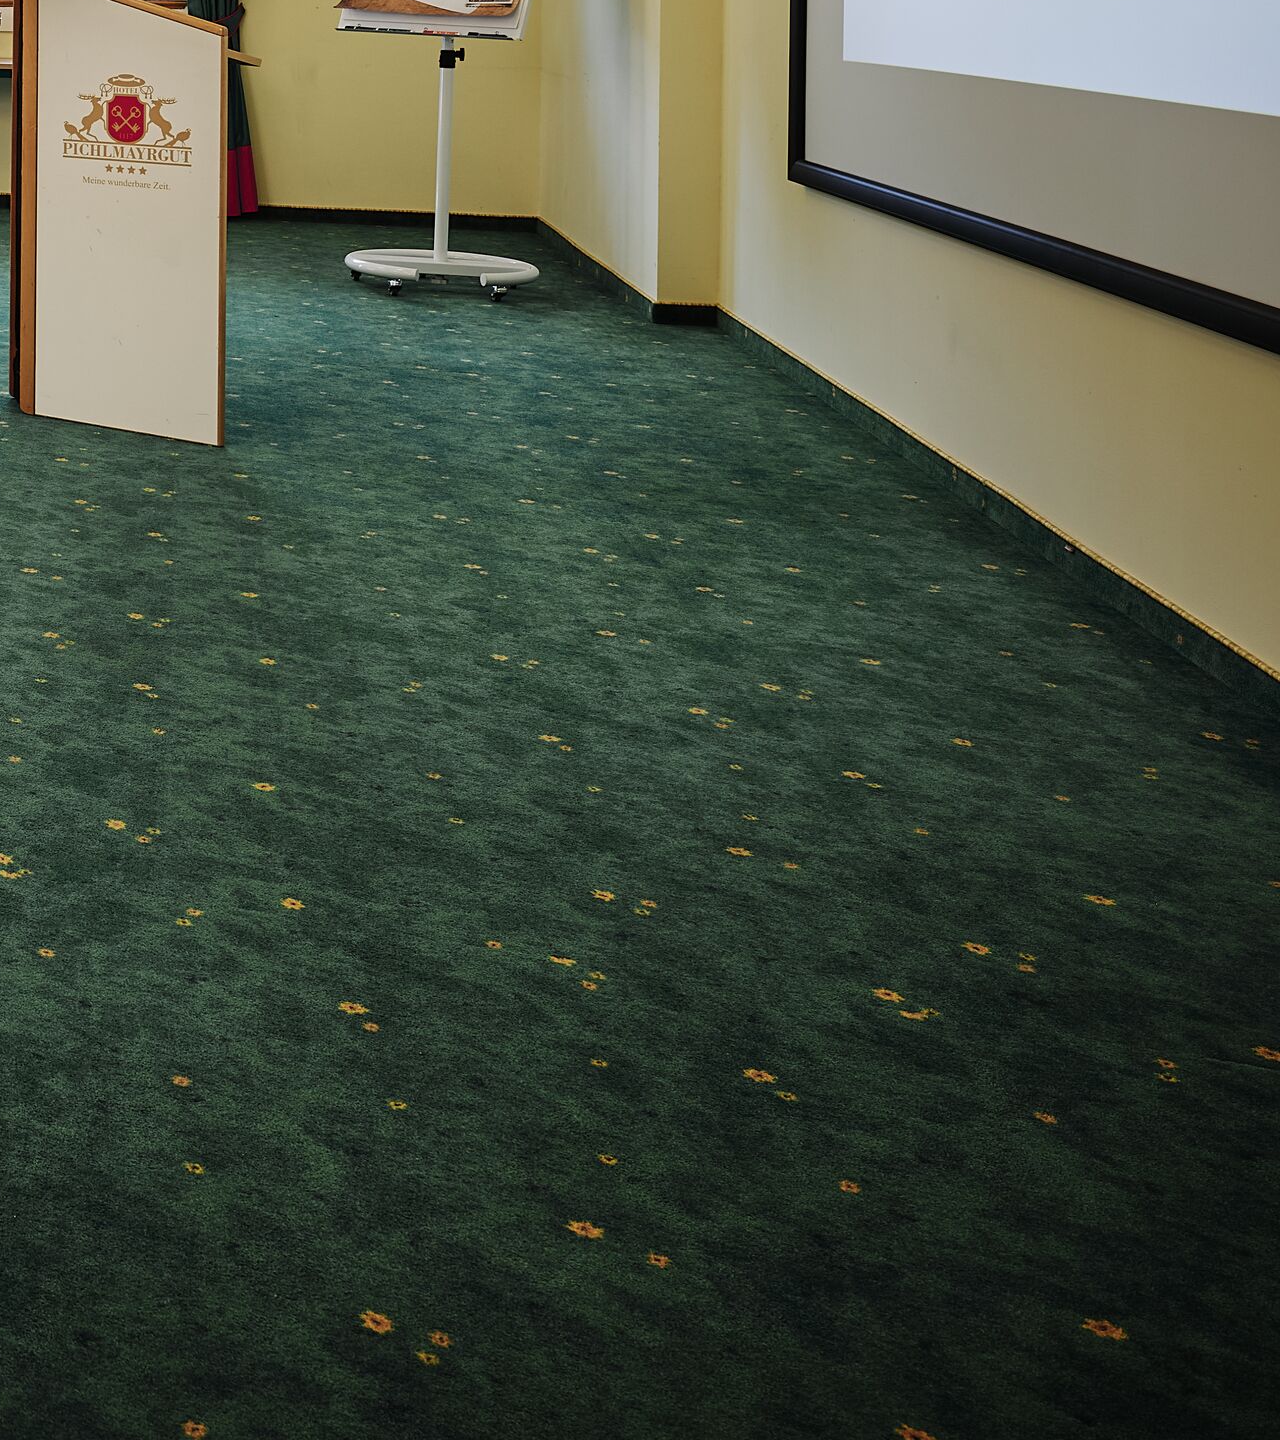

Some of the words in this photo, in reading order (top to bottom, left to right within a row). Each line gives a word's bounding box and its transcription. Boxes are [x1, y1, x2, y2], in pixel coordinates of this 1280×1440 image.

[112, 86, 140, 94] HOTEL
[62, 142, 193, 164] PICHLMAYRGUT
[82, 176, 106, 185] Meine
[107, 179, 152, 189] wunderbare
